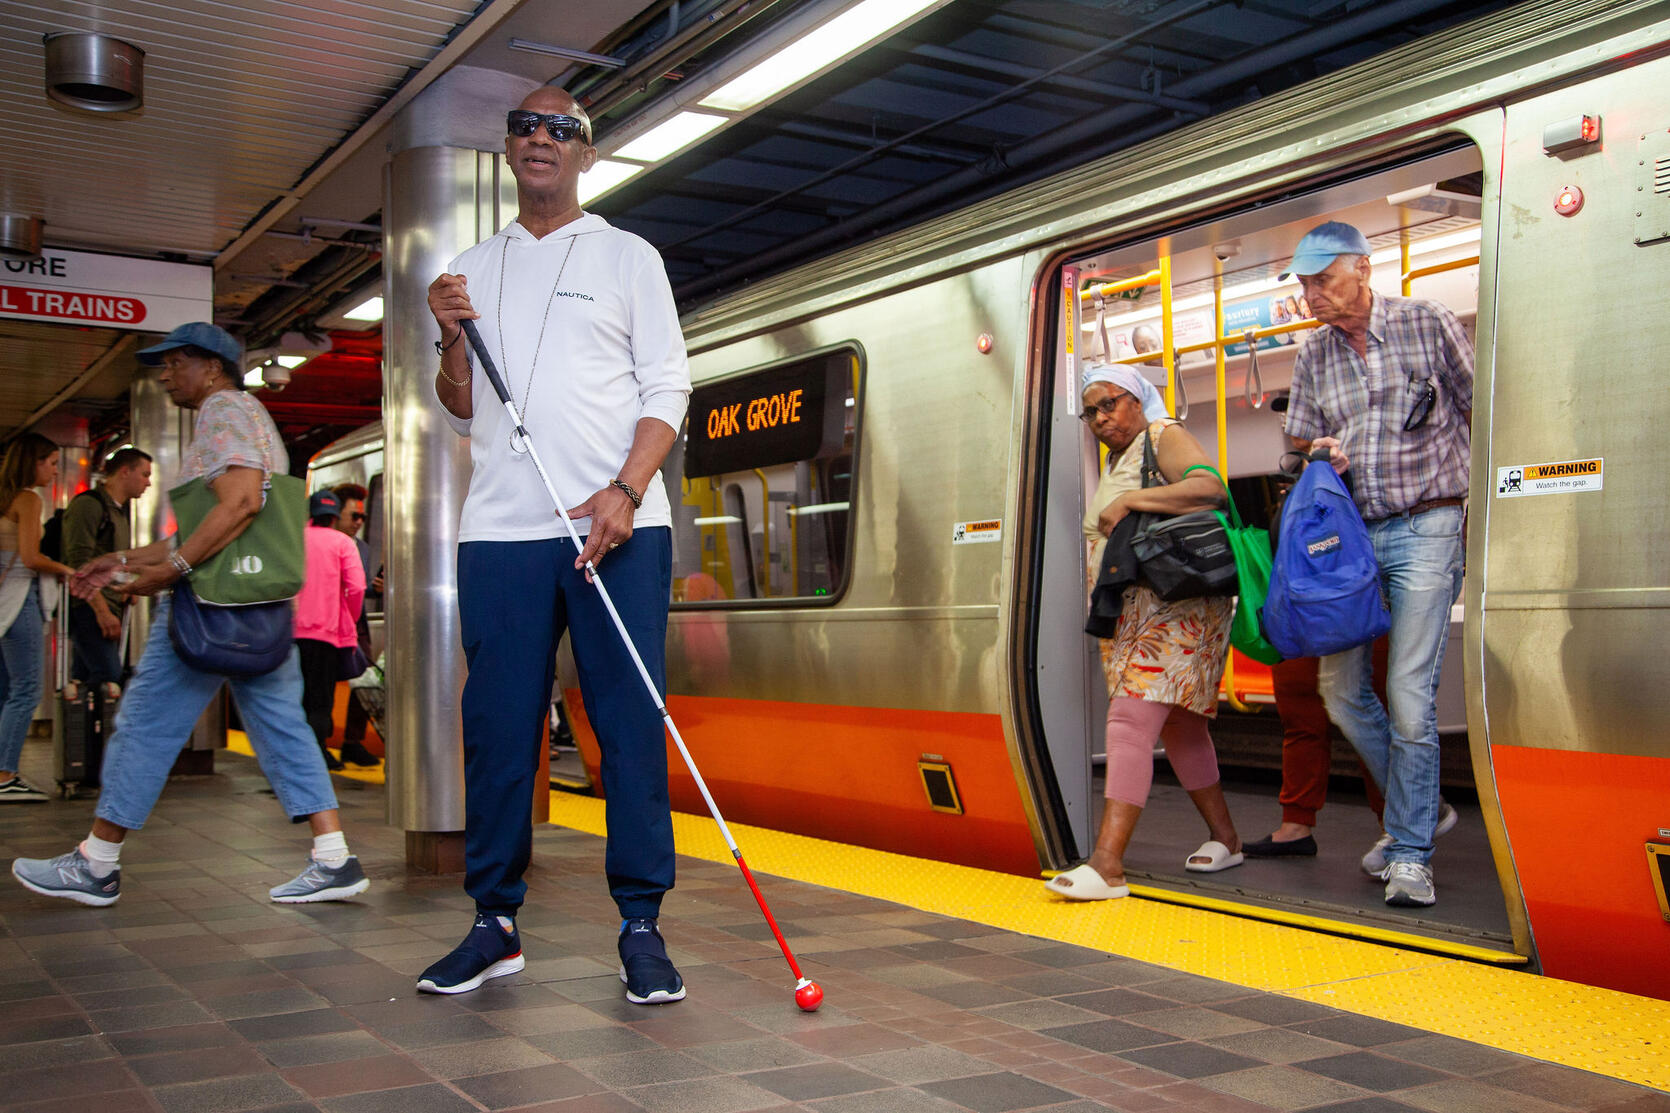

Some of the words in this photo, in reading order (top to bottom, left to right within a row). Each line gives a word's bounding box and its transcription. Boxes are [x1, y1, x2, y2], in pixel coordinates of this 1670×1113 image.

[556, 291, 595, 302] NAUTICA
[26, 291, 135, 321] TRAINS
[707, 403, 742, 440] OAK
[746, 389, 803, 432] GROVE
[1538, 462, 1597, 476] WARNING
[1536, 481, 1558, 489] Watch
[1572, 480, 1588, 488] gap.
